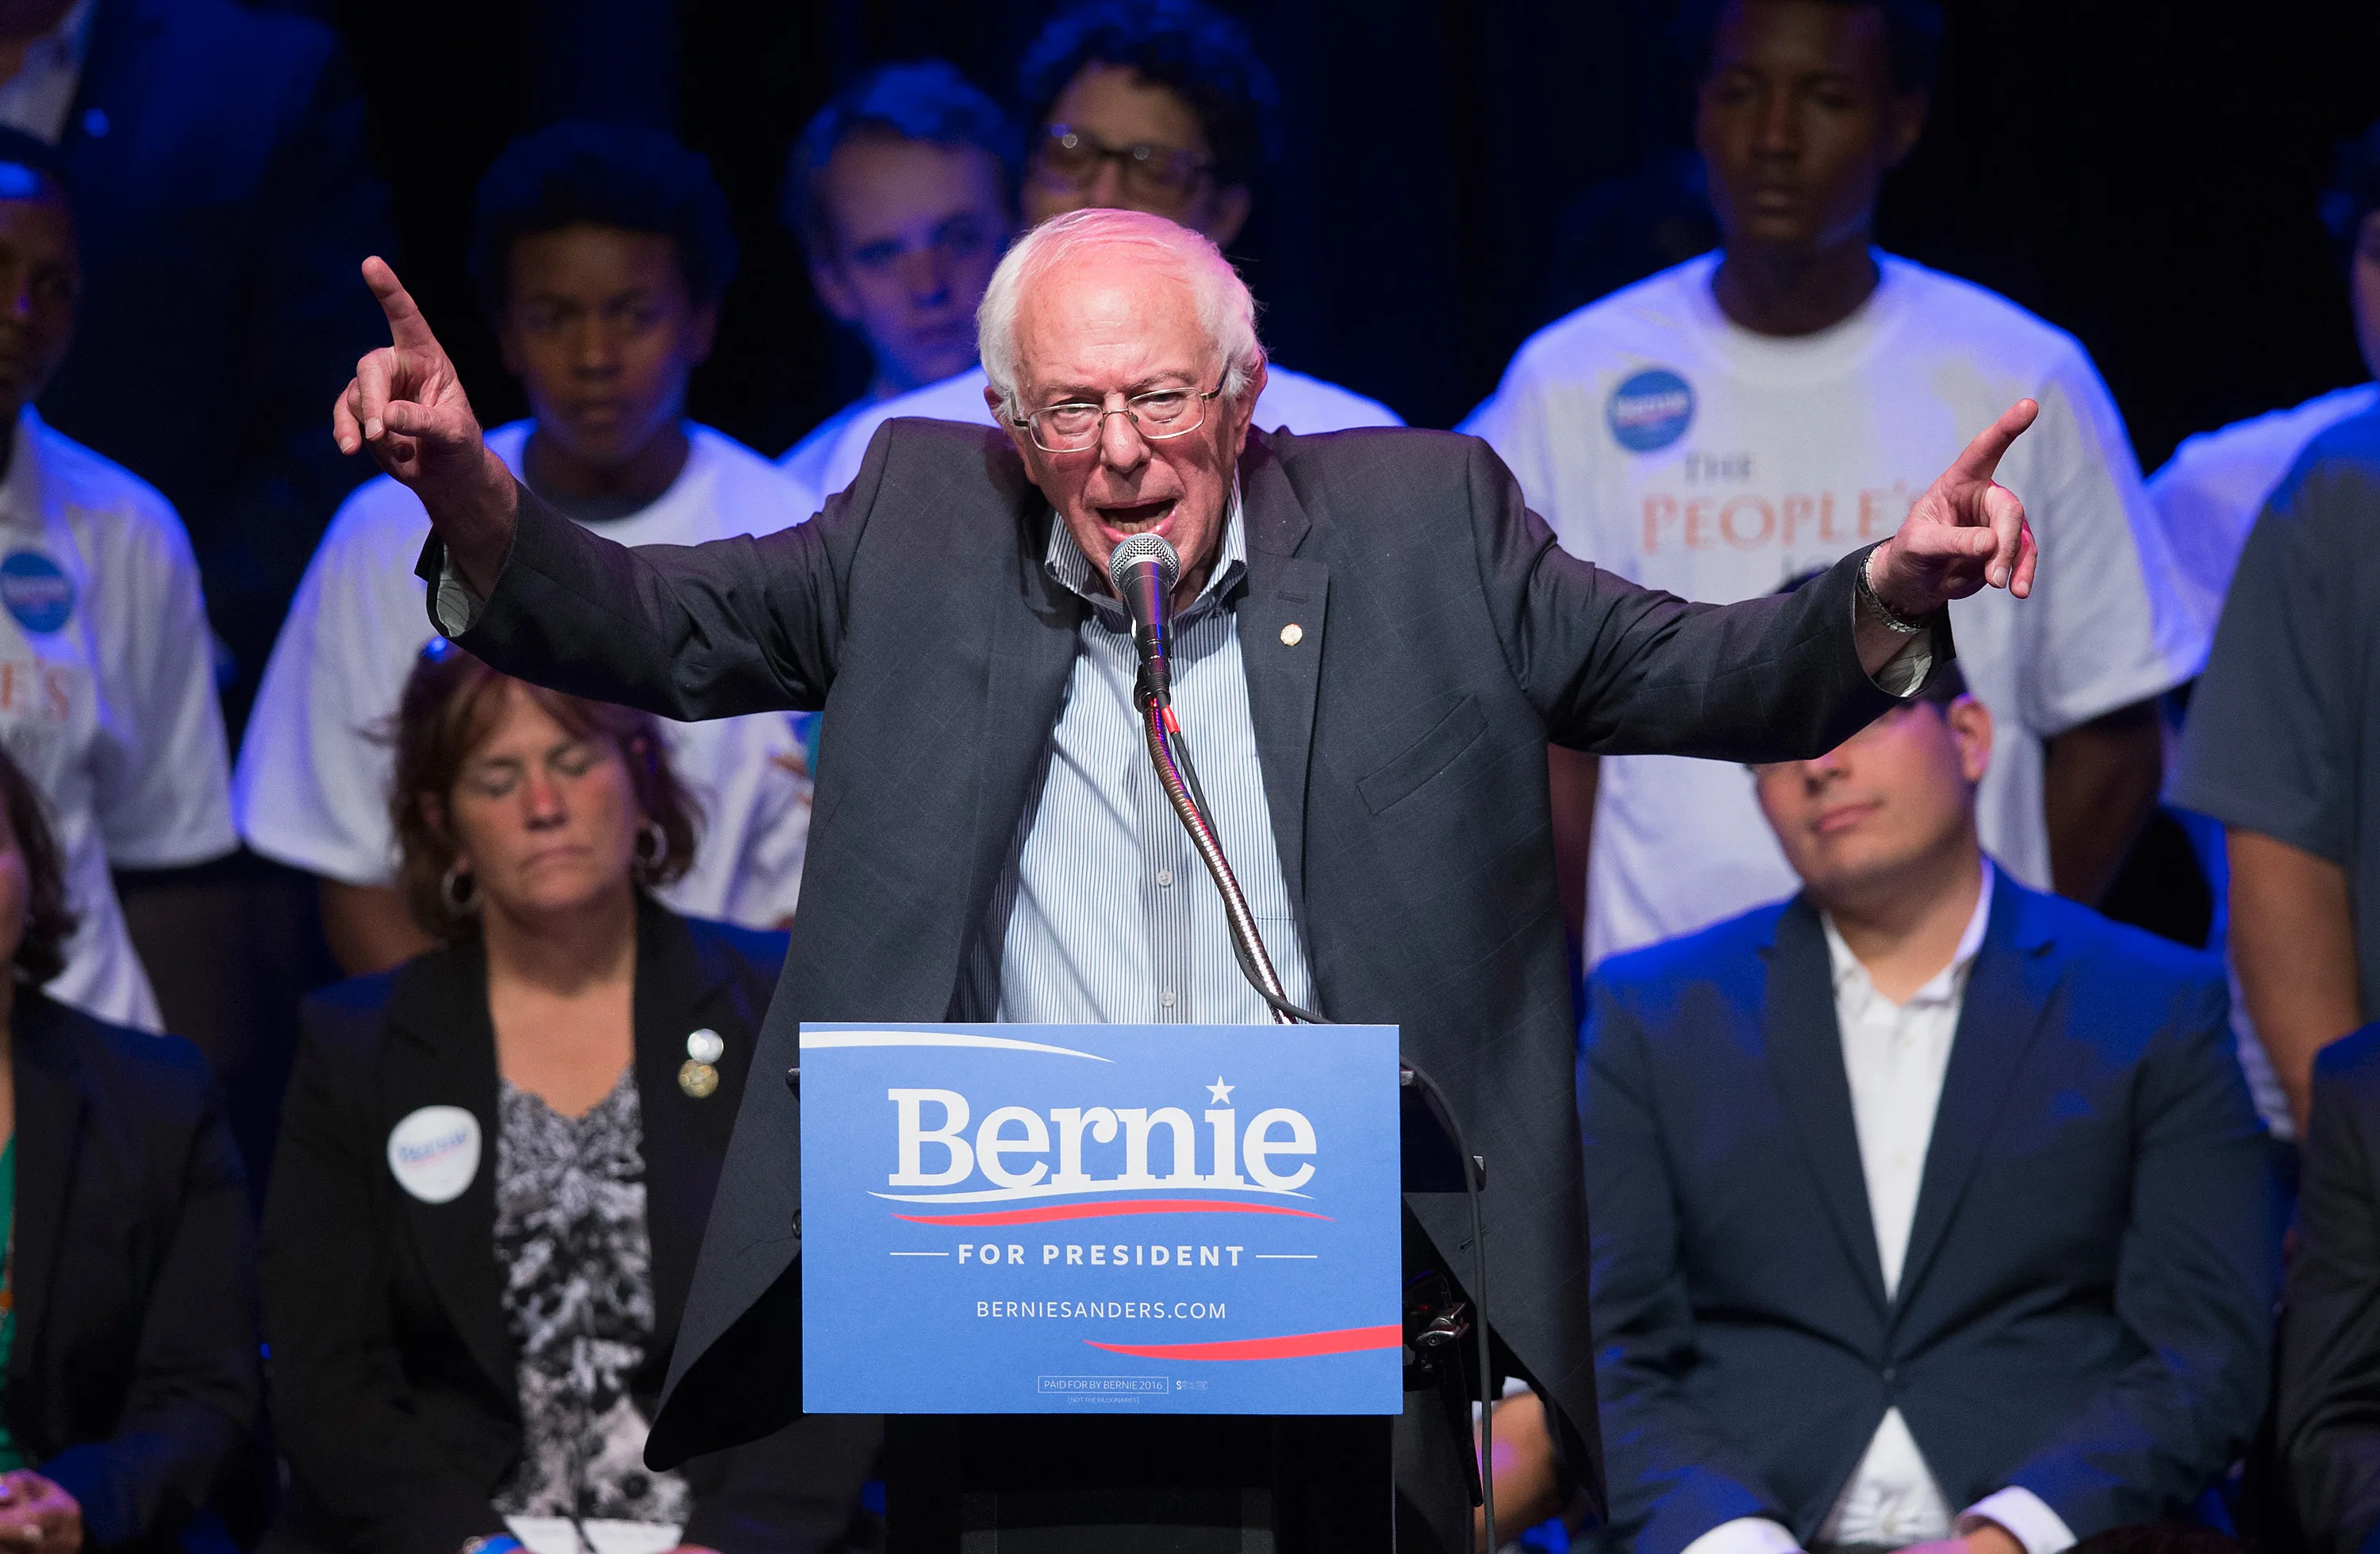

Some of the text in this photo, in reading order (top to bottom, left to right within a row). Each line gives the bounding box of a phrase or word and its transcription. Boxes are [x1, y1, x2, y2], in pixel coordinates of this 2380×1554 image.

[1641, 478, 1927, 556] PEOPLE'
[888, 1076, 1318, 1190] Bernie
[958, 1244, 1244, 1267] FOR PRESIDENT
[977, 1301, 1226, 1320] BERNIESANDERS.COM
[1044, 1379, 1163, 1390] PAID FOR BY BERNIE 2016
